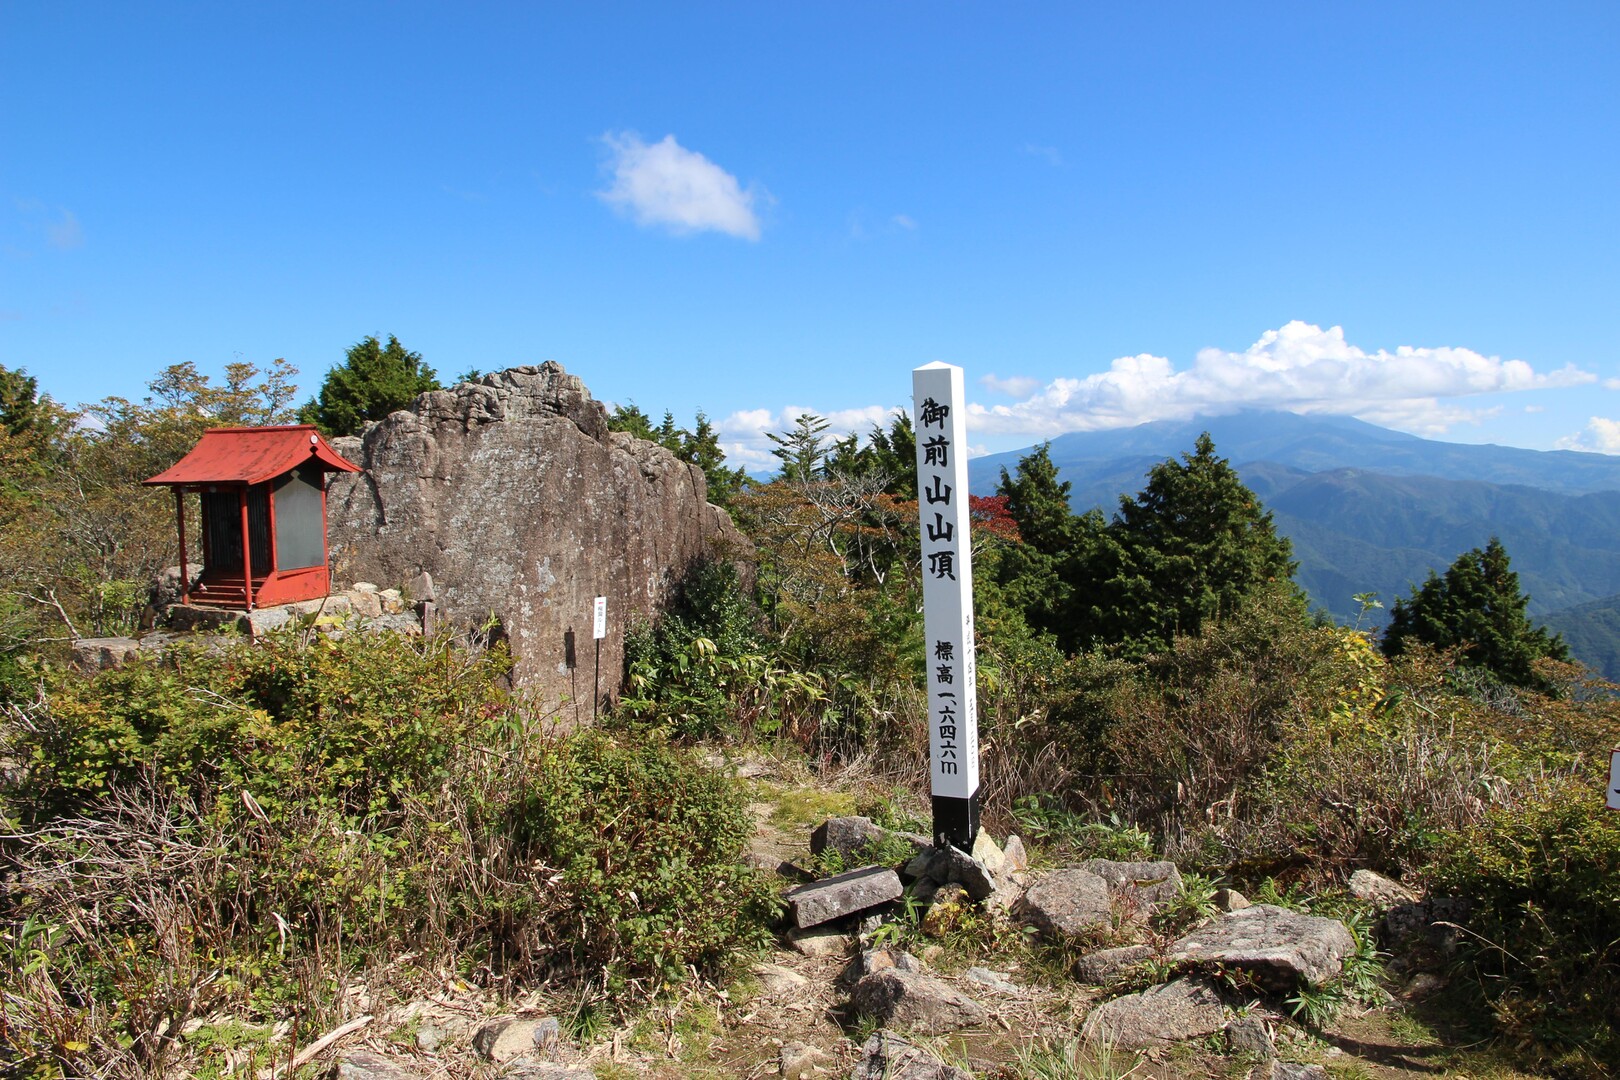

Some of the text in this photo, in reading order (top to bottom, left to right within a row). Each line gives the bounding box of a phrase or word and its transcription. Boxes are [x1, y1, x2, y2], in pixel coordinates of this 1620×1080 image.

[920, 398, 956, 581] 御前山山頂
